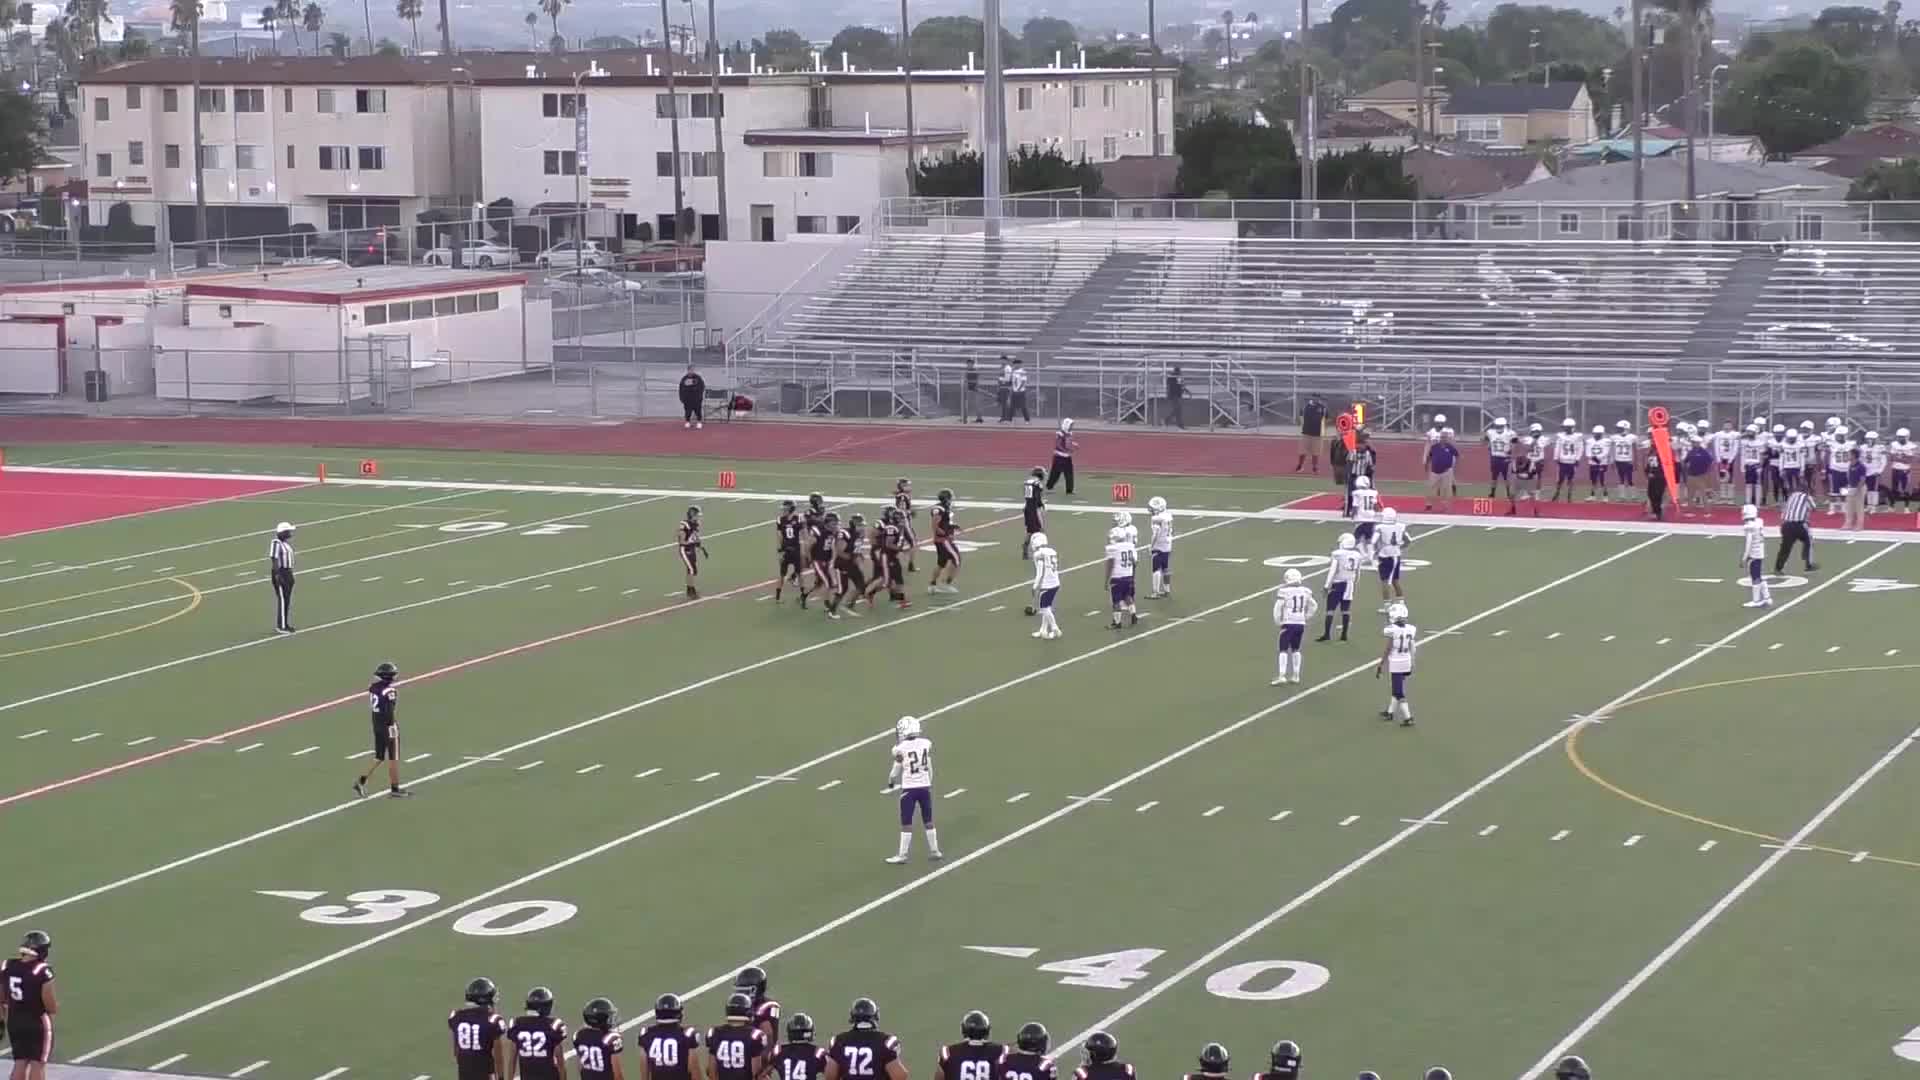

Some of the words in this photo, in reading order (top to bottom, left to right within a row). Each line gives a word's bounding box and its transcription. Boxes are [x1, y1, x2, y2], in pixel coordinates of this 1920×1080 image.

[908, 748, 929, 774] 24
[9, 976, 23, 1001] 5
[457, 1022, 481, 1051] 81
[518, 1031, 547, 1057] 32
[578, 1045, 604, 1073] 20
[649, 1038, 679, 1067] 40
[717, 1040, 745, 1068] 48
[845, 1046, 874, 1075] 72
[784, 1058, 807, 1080] 14
